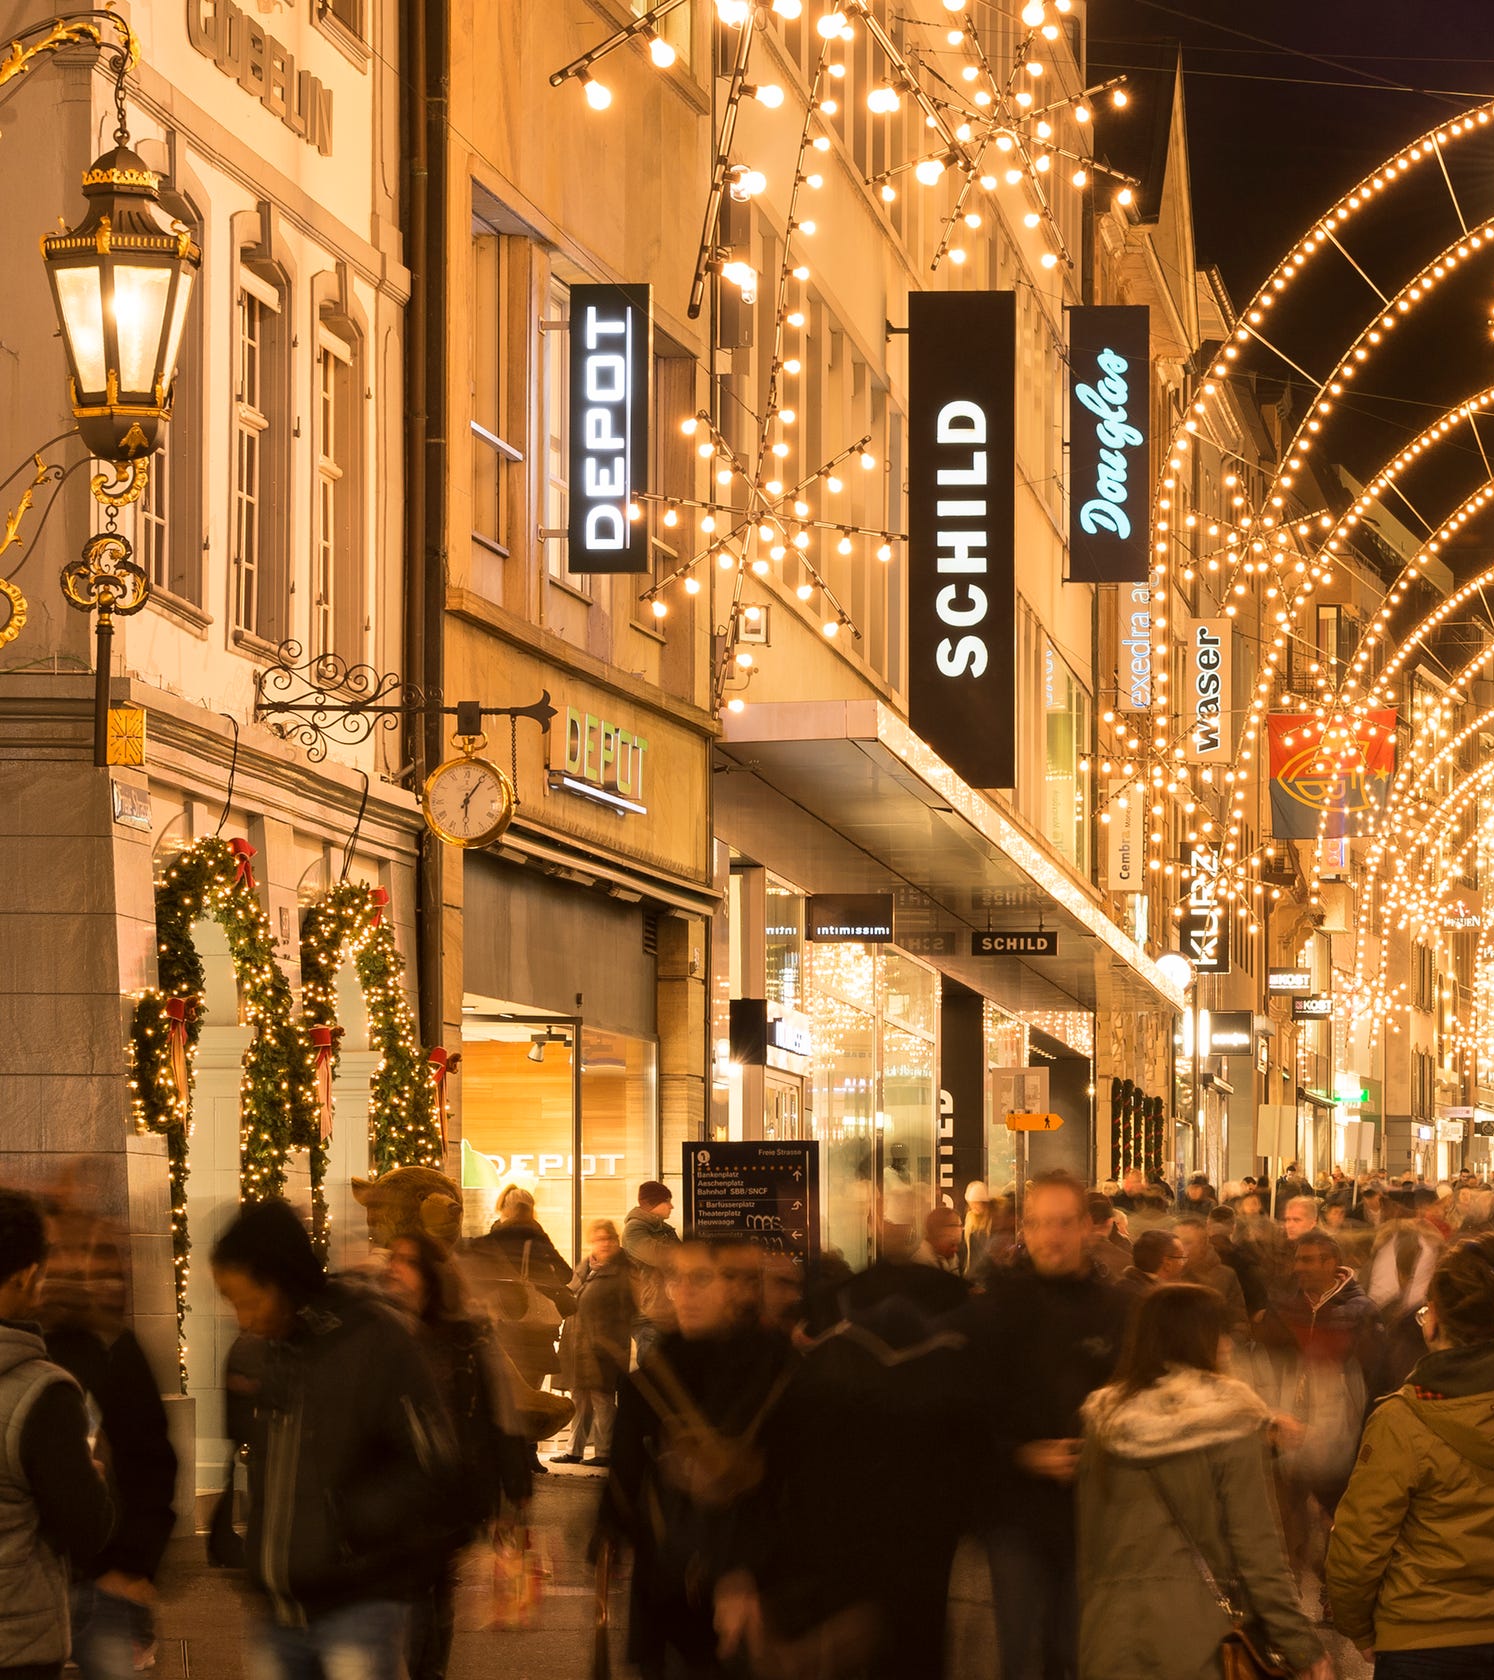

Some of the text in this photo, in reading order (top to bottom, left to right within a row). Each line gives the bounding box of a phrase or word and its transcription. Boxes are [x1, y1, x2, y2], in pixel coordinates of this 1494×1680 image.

[586, 306, 626, 549] DEPOT
[1076, 348, 1144, 540] Douglas
[936, 400, 988, 679] SCHILD
[1122, 612, 1150, 708] exedra
[1197, 626, 1220, 753] waser
[566, 706, 648, 800] DEPOT
[1118, 831, 1131, 880] Cembra
[817, 926, 889, 935] intimissimi
[982, 937, 1048, 950] SCHILD
[1191, 850, 1218, 965] KURZ
[484, 1154, 624, 1176] DEPOT
